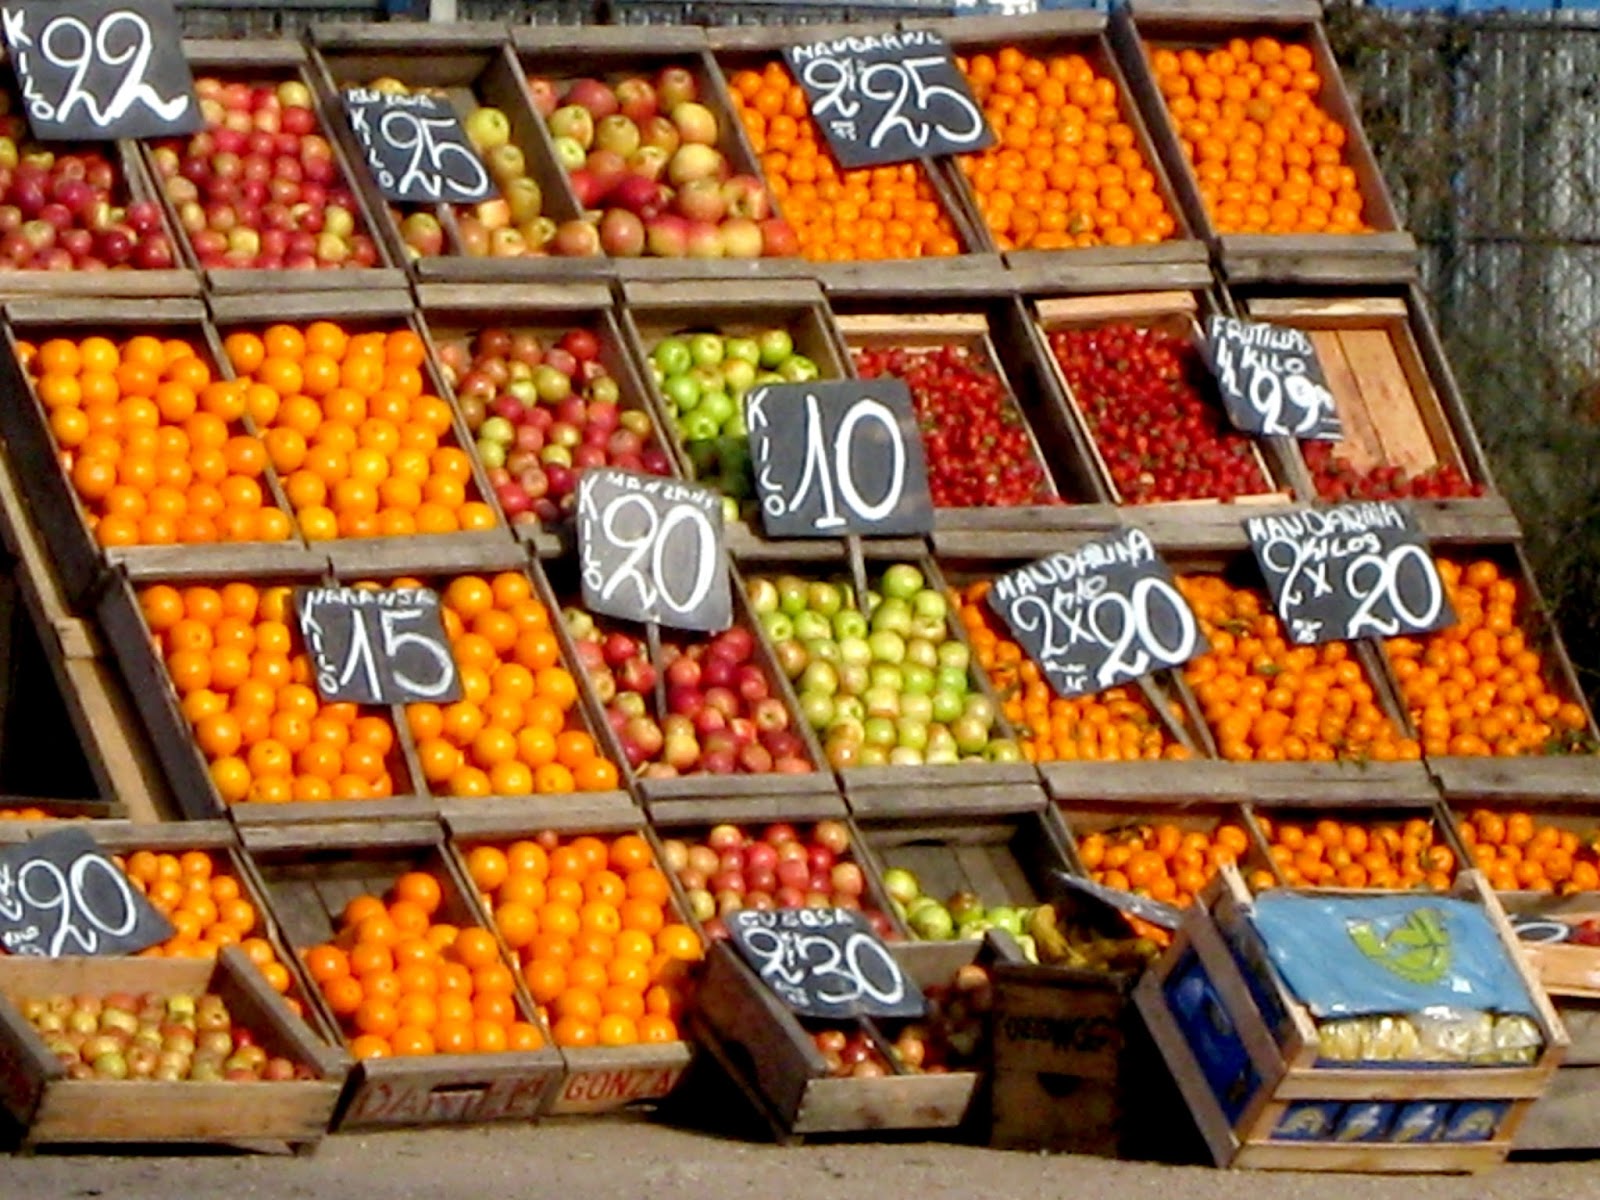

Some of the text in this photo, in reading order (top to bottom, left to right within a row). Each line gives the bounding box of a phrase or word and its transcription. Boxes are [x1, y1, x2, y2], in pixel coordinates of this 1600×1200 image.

[750, 388, 785, 516] KILO
[789, 395, 905, 528] 10
[340, 608, 454, 701] 15
[800, 933, 904, 1004] 30
